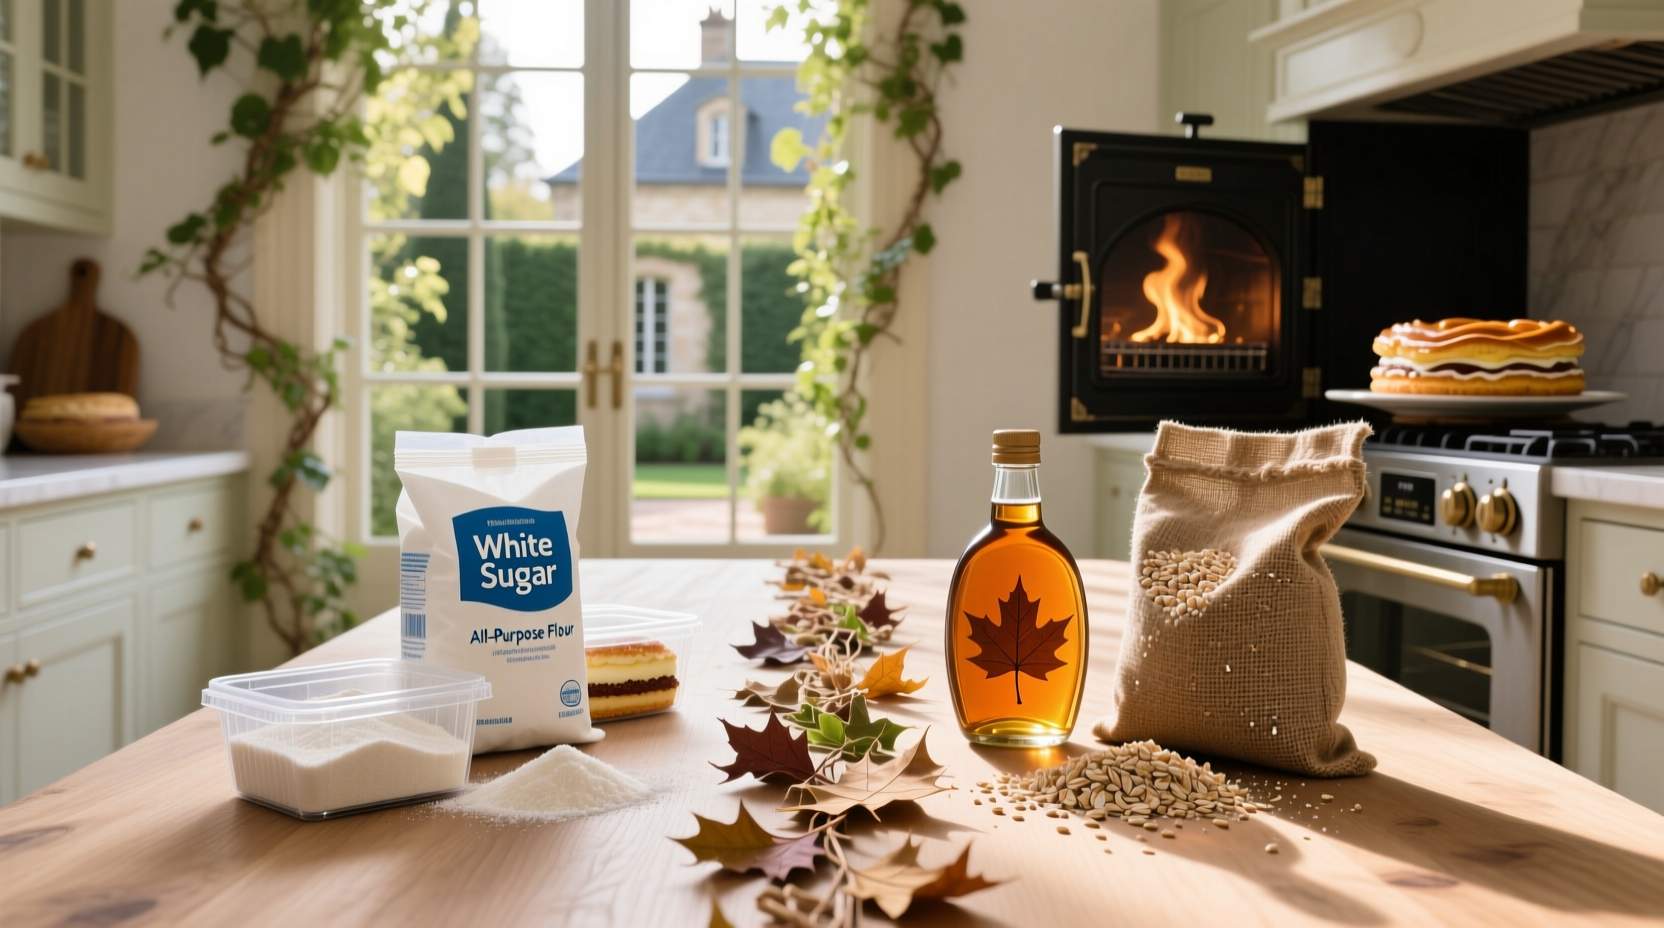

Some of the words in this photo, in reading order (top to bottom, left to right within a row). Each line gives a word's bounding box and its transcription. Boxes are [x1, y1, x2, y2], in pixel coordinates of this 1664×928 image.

[472, 532, 553, 560] White
[480, 562, 557, 595] Sugar
[470, 628, 545, 646] All-Purpose
[547, 622, 575, 639] Flour
